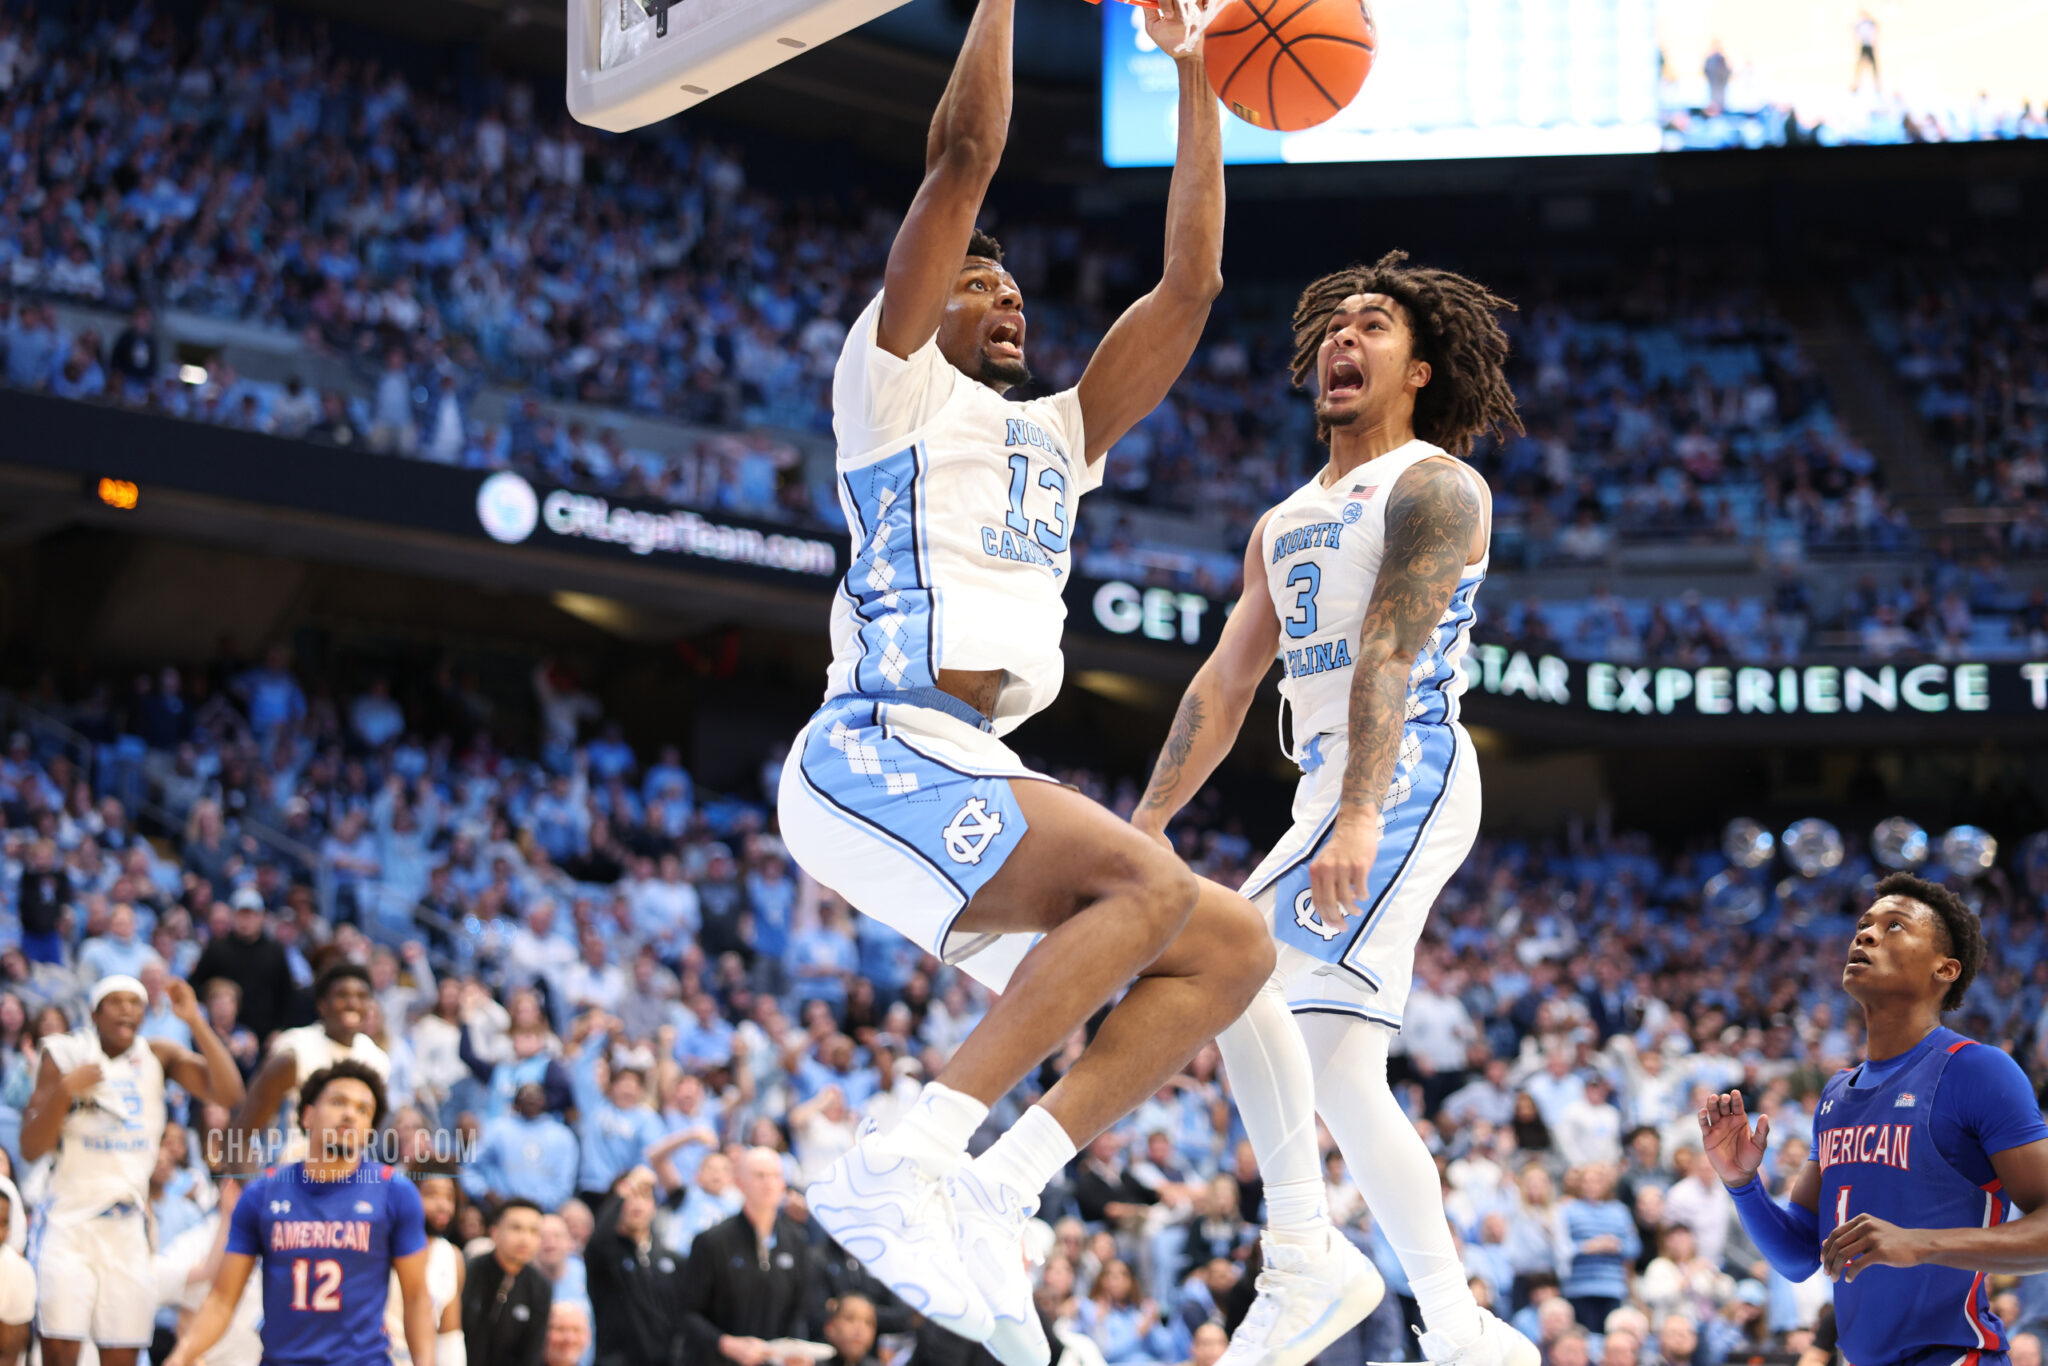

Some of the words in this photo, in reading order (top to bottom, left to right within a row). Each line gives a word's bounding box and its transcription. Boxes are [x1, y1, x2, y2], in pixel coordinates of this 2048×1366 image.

[1005, 418, 1066, 463] NOR
[1006, 453, 1069, 553] 13
[981, 525, 1063, 577] CARO
[1273, 522, 1344, 565] NORTH
[1092, 580, 1209, 645] GET
[1286, 561, 1321, 638] 3
[1586, 661, 1991, 715] EXPERIENCE
[1818, 1124, 1913, 1176] MERICAN
[271, 1220, 372, 1253] AMERICAN
[1835, 1185, 1853, 1236] 1
[290, 1257, 343, 1312] 12
